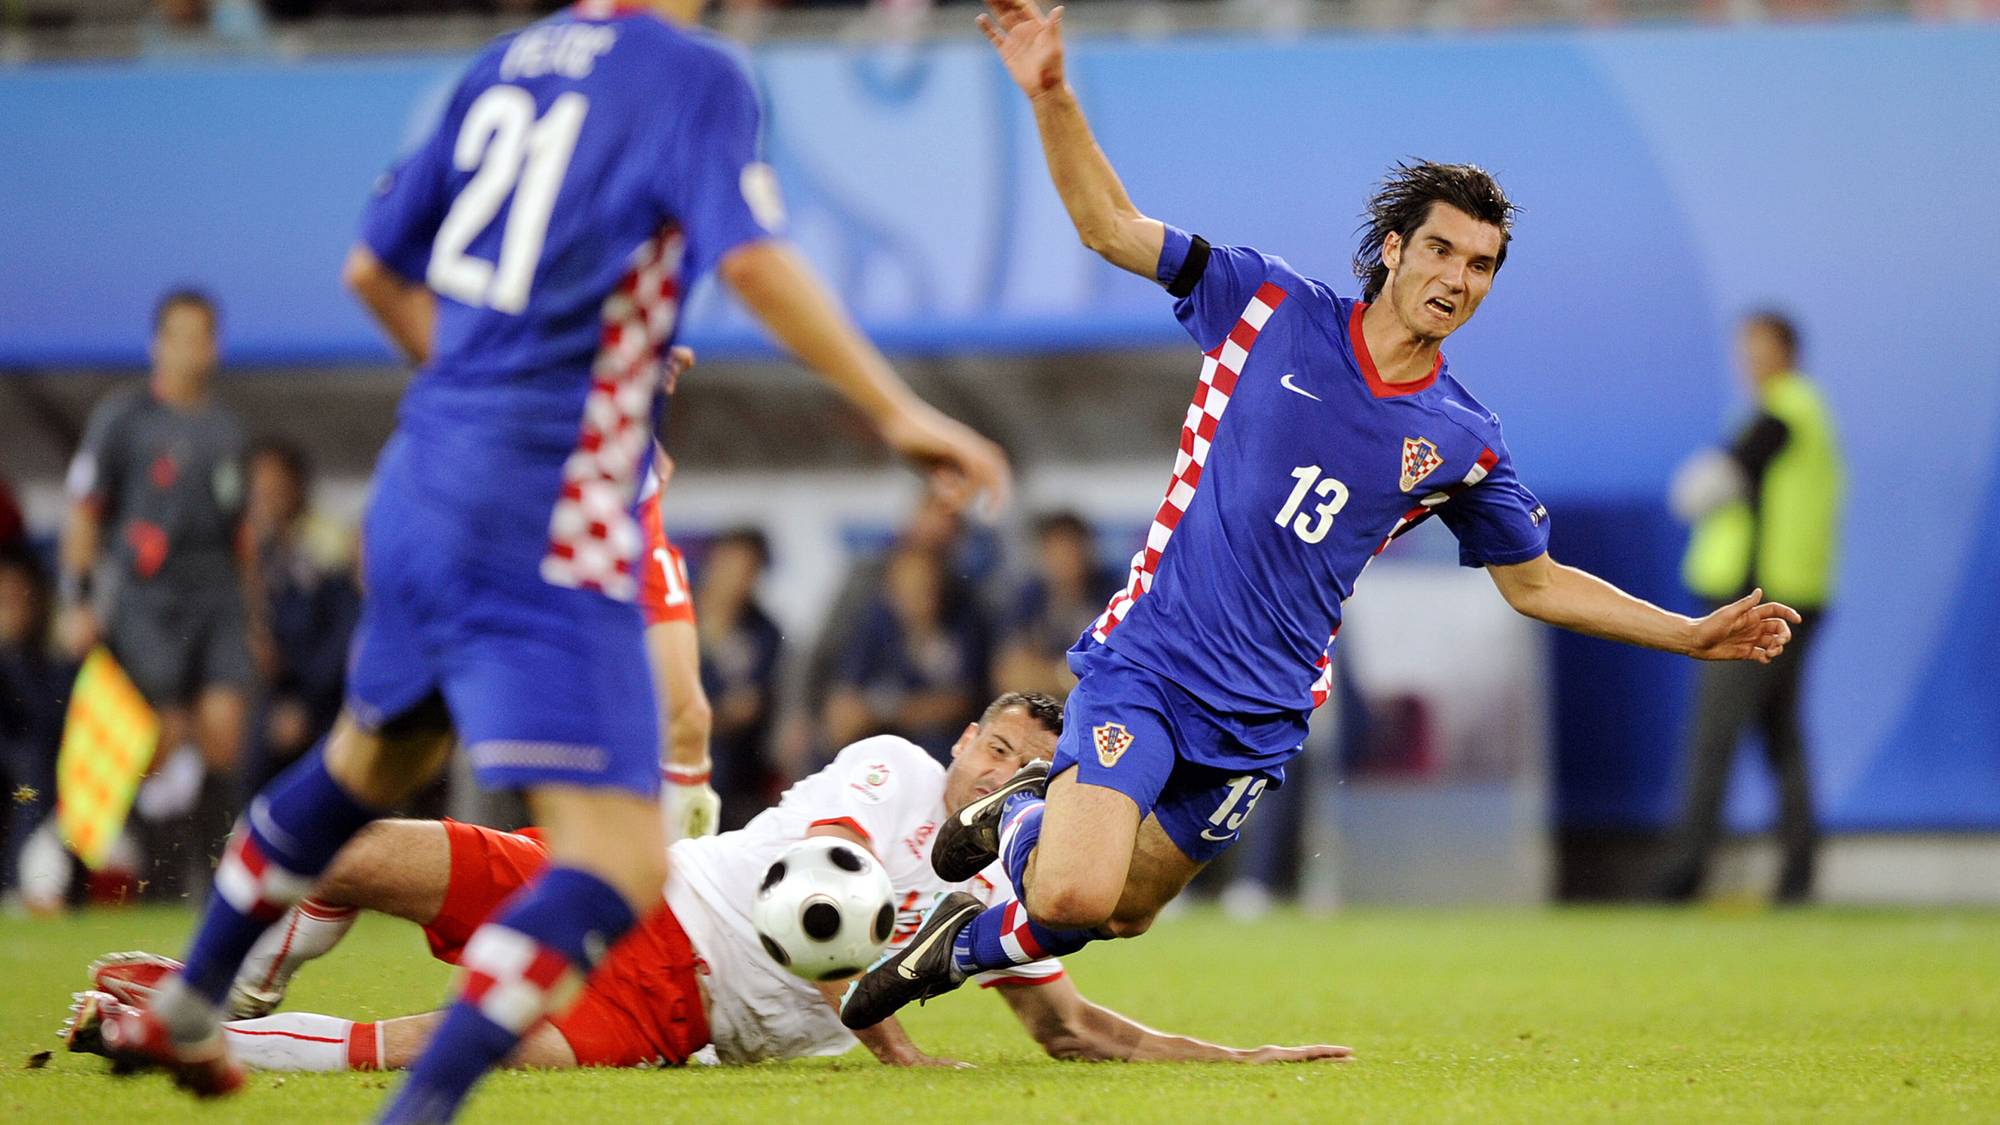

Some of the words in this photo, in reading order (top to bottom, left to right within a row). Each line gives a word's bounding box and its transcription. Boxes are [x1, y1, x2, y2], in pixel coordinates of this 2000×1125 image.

[425, 84, 589, 315] 21
[1274, 464, 1350, 544] 13
[653, 547, 688, 607] 1
[1208, 775, 1268, 830] 13
